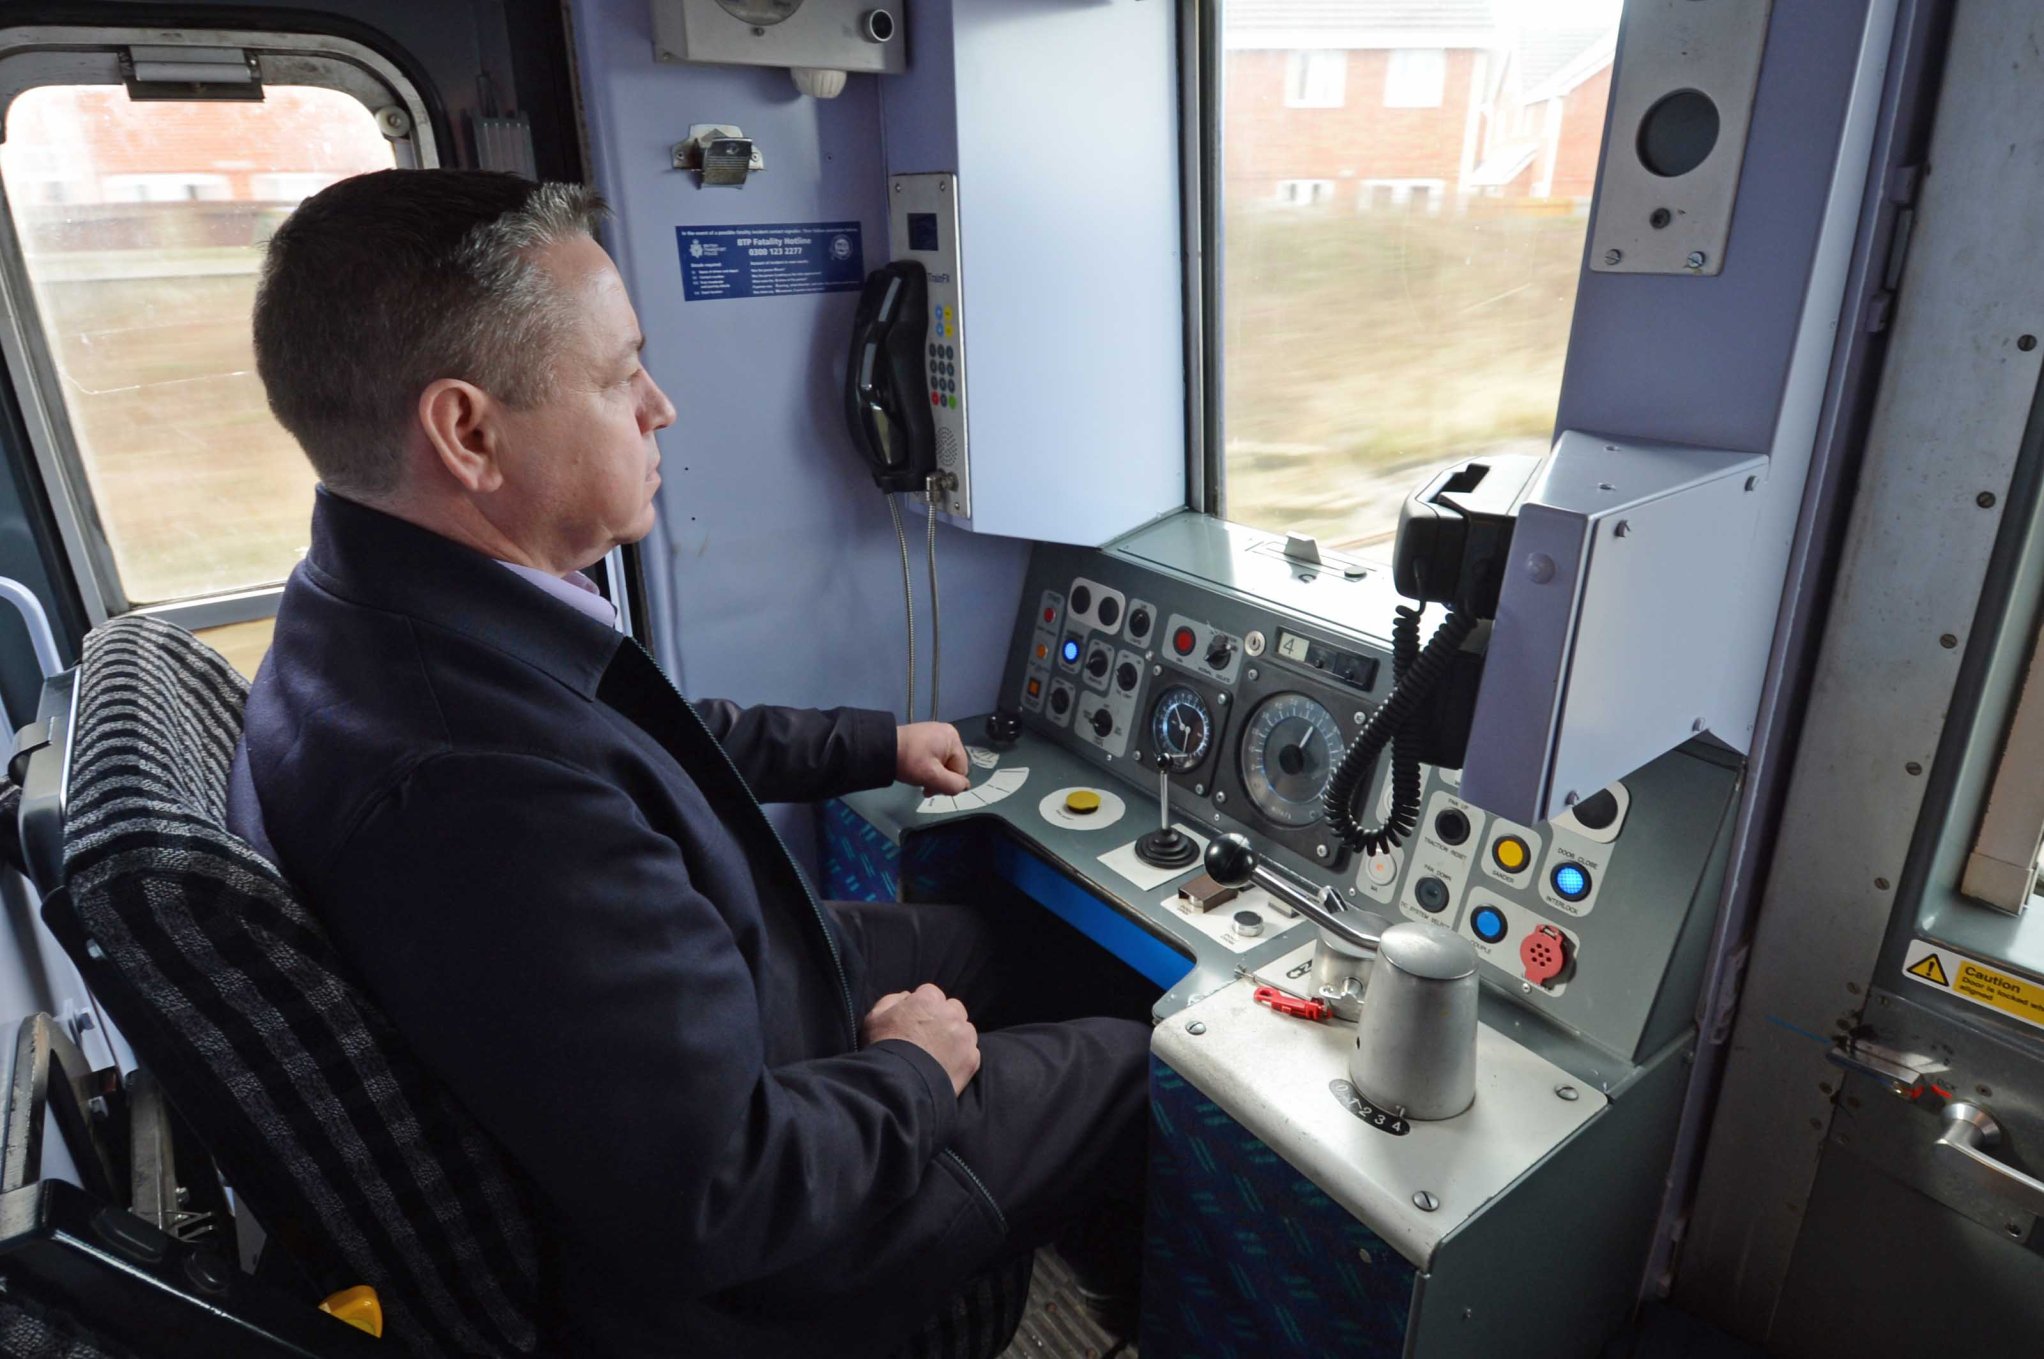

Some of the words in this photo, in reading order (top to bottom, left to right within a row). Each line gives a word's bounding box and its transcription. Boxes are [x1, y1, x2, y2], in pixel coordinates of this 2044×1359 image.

[737, 238, 751, 246] BTP
[753, 237, 782, 247] Fatality
[784, 236, 812, 245] Hotline
[748, 248, 768, 256] 0300
[769, 248, 783, 256] 123
[784, 247, 802, 255] 2277
[1283, 638, 1295, 655] 4
[1557, 847, 1576, 860] DOOR
[1577, 856, 1599, 871] CLOSE
[1492, 870, 1515, 883] SANDER
[1546, 895, 1579, 915] INTERLOCK
[1965, 966, 2021, 994] Caution
[1959, 985, 1994, 1002] aligned
[1961, 976, 1985, 989] Door
[1987, 985, 1995, 993] is
[1998, 989, 2029, 1006] locked
[1358, 1107, 1373, 1117] 2
[1374, 1114, 1386, 1125] 3
[1392, 1121, 1402, 1132] 4
